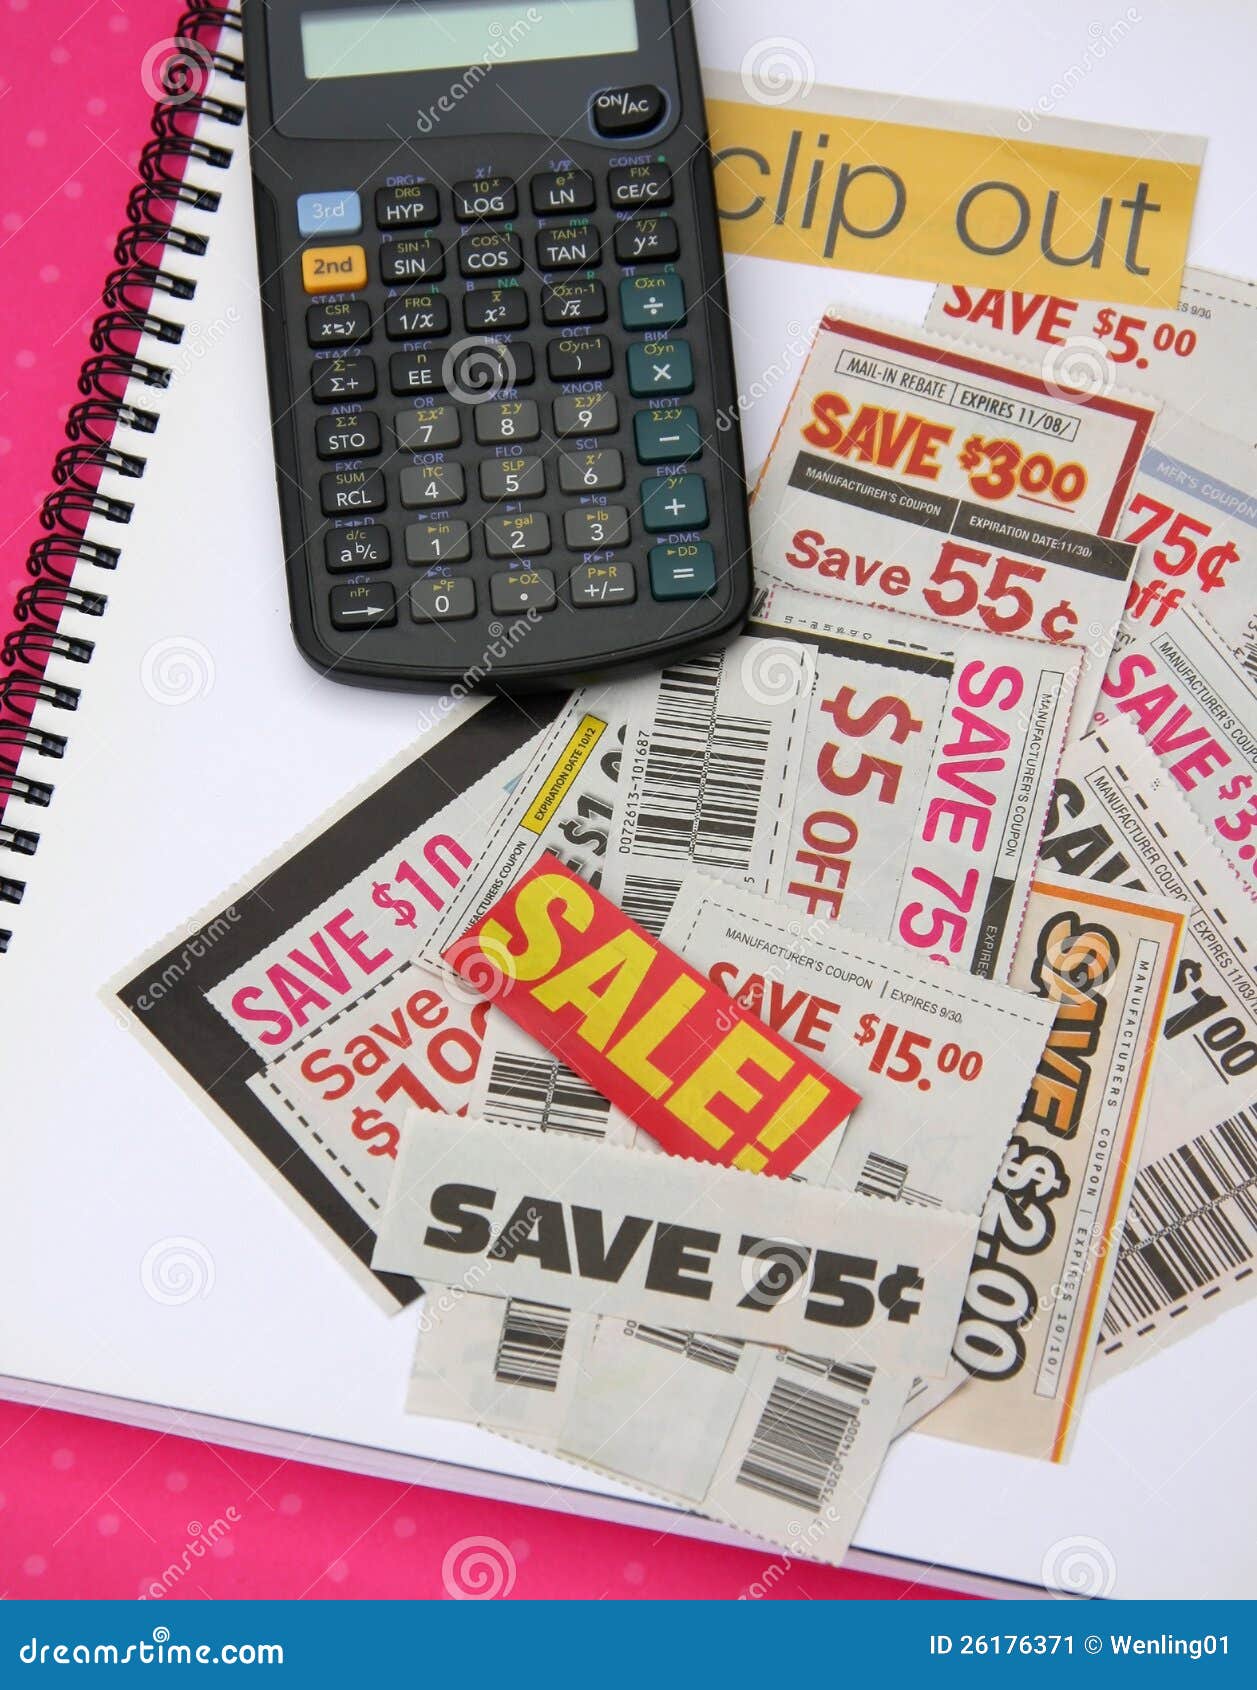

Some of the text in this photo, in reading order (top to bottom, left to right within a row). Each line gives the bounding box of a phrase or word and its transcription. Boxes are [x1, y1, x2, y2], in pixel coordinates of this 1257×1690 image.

[598, 92, 649, 115] ON/AC
[395, 187, 421, 198] DRG
[550, 189, 575, 205] LN
[616, 182, 659, 199] CE/C
[312, 200, 345, 219] 3rd
[387, 203, 424, 220] HYP
[464, 196, 504, 214] LOG
[711, 130, 1161, 276] clip out
[468, 251, 508, 268] COS
[547, 244, 586, 262] TAN
[313, 257, 353, 275] 2nd
[395, 258, 426, 275] SIN
[325, 304, 350, 315] CSR
[405, 297, 432, 308] FRQ
[943, 284, 1079, 346] SAVE
[408, 369, 432, 385] EE
[562, 382, 603, 394] XNOR
[847, 357, 898, 389] MAIL-IN
[900, 372, 948, 399] REBATE
[958, 390, 1015, 419] EXPIRES
[501, 418, 515, 435] 8
[578, 411, 592, 428] 9
[328, 433, 365, 450] STO
[420, 425, 433, 443] 7
[801, 390, 955, 480] SAVE
[495, 445, 522, 457] FLO
[576, 438, 598, 450] SCI
[502, 461, 525, 472] SLP
[336, 472, 365, 484] SUM
[506, 475, 519, 492] 5
[584, 468, 598, 485] 6
[337, 490, 371, 506] RCL
[424, 482, 439, 499] 4
[805, 467, 897, 503] MANUFACTURER'S
[898, 495, 941, 517] COUPON
[968, 516, 1030, 542] EXPIRATION
[510, 531, 526, 549] 2
[590, 524, 604, 541] 3
[431, 539, 441, 556] 1
[1123, 493, 1240, 593] 75¢
[785, 529, 911, 597] Save
[435, 596, 450, 613] 0
[1159, 641, 1257, 764] MANUFACTURER'S COUPO
[1101, 654, 1232, 792] SAVE
[816, 685, 924, 805] $5
[1017, 693, 1052, 803] MANUFACTURER'S
[922, 660, 1024, 853] SAVE
[618, 730, 651, 854] 0072613-101687
[499, 841, 527, 879] COUPON
[534, 771, 569, 821] EXPIRATION
[564, 749, 583, 772] DATE
[1006, 802, 1027, 857] COUPON
[787, 810, 859, 921] OFF
[1092, 776, 1161, 864] MANUFACTURER
[1154, 862, 1189, 902] COUPO
[1193, 919, 1233, 969] EXPIRES
[231, 907, 394, 1046] SAVE
[725, 927, 825, 972] MANUFACTURER'S
[826, 964, 874, 991] COUPON
[890, 988, 938, 1015] EXPIRES
[478, 873, 831, 1175] SALE!
[707, 960, 983, 1092] SAVE $15.00
[1018, 911, 1120, 1140] SAVE
[1107, 960, 1150, 1108] MANUFACTURERS
[301, 989, 450, 1101] Save
[1087, 1128, 1110, 1197] COUPON
[423, 1183, 926, 1328] SAVE 75¢
